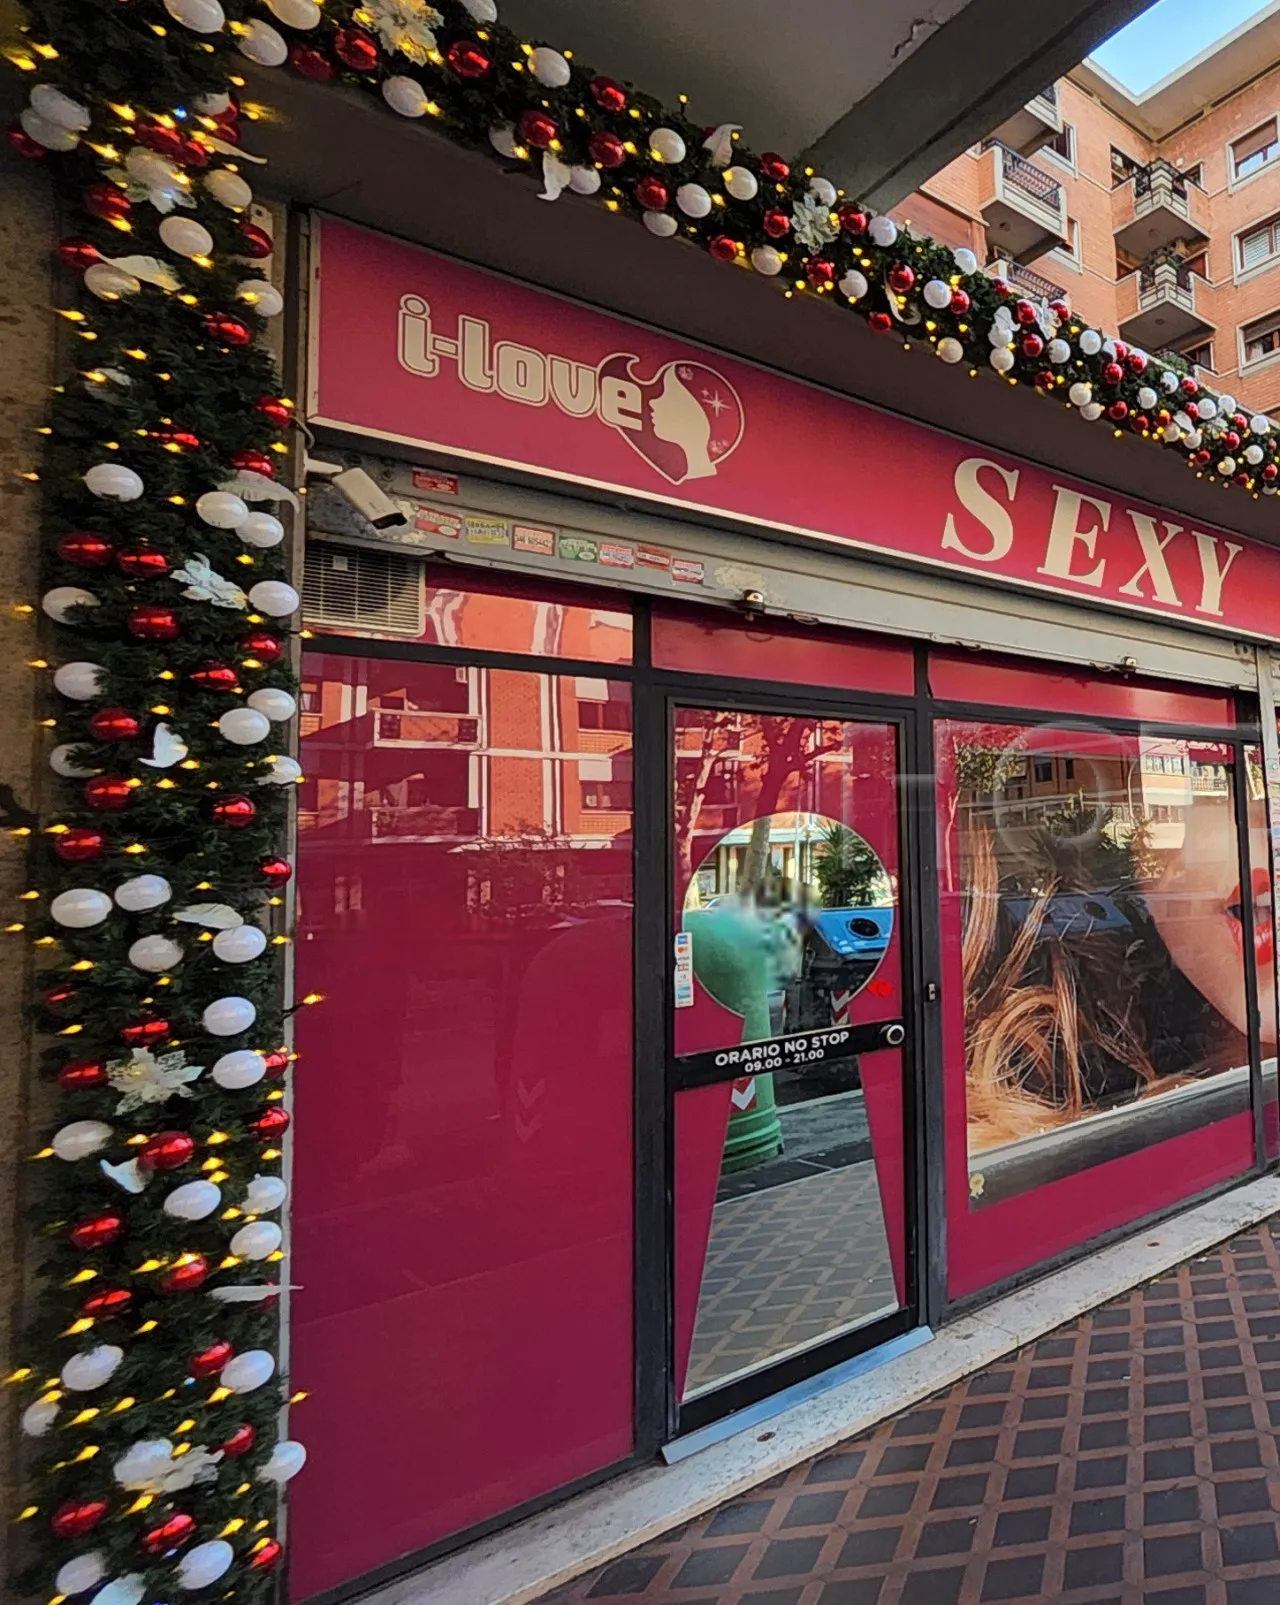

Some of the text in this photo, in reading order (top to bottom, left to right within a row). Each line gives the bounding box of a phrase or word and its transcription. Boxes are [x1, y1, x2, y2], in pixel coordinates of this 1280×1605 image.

[398, 294, 643, 431] i-love
[941, 457, 1244, 617] SEXY
[715, 1031, 849, 1066] ORARIO NO STOP
[745, 1057, 782, 1072] 09.00
[793, 1050, 824, 1064] 21.00
